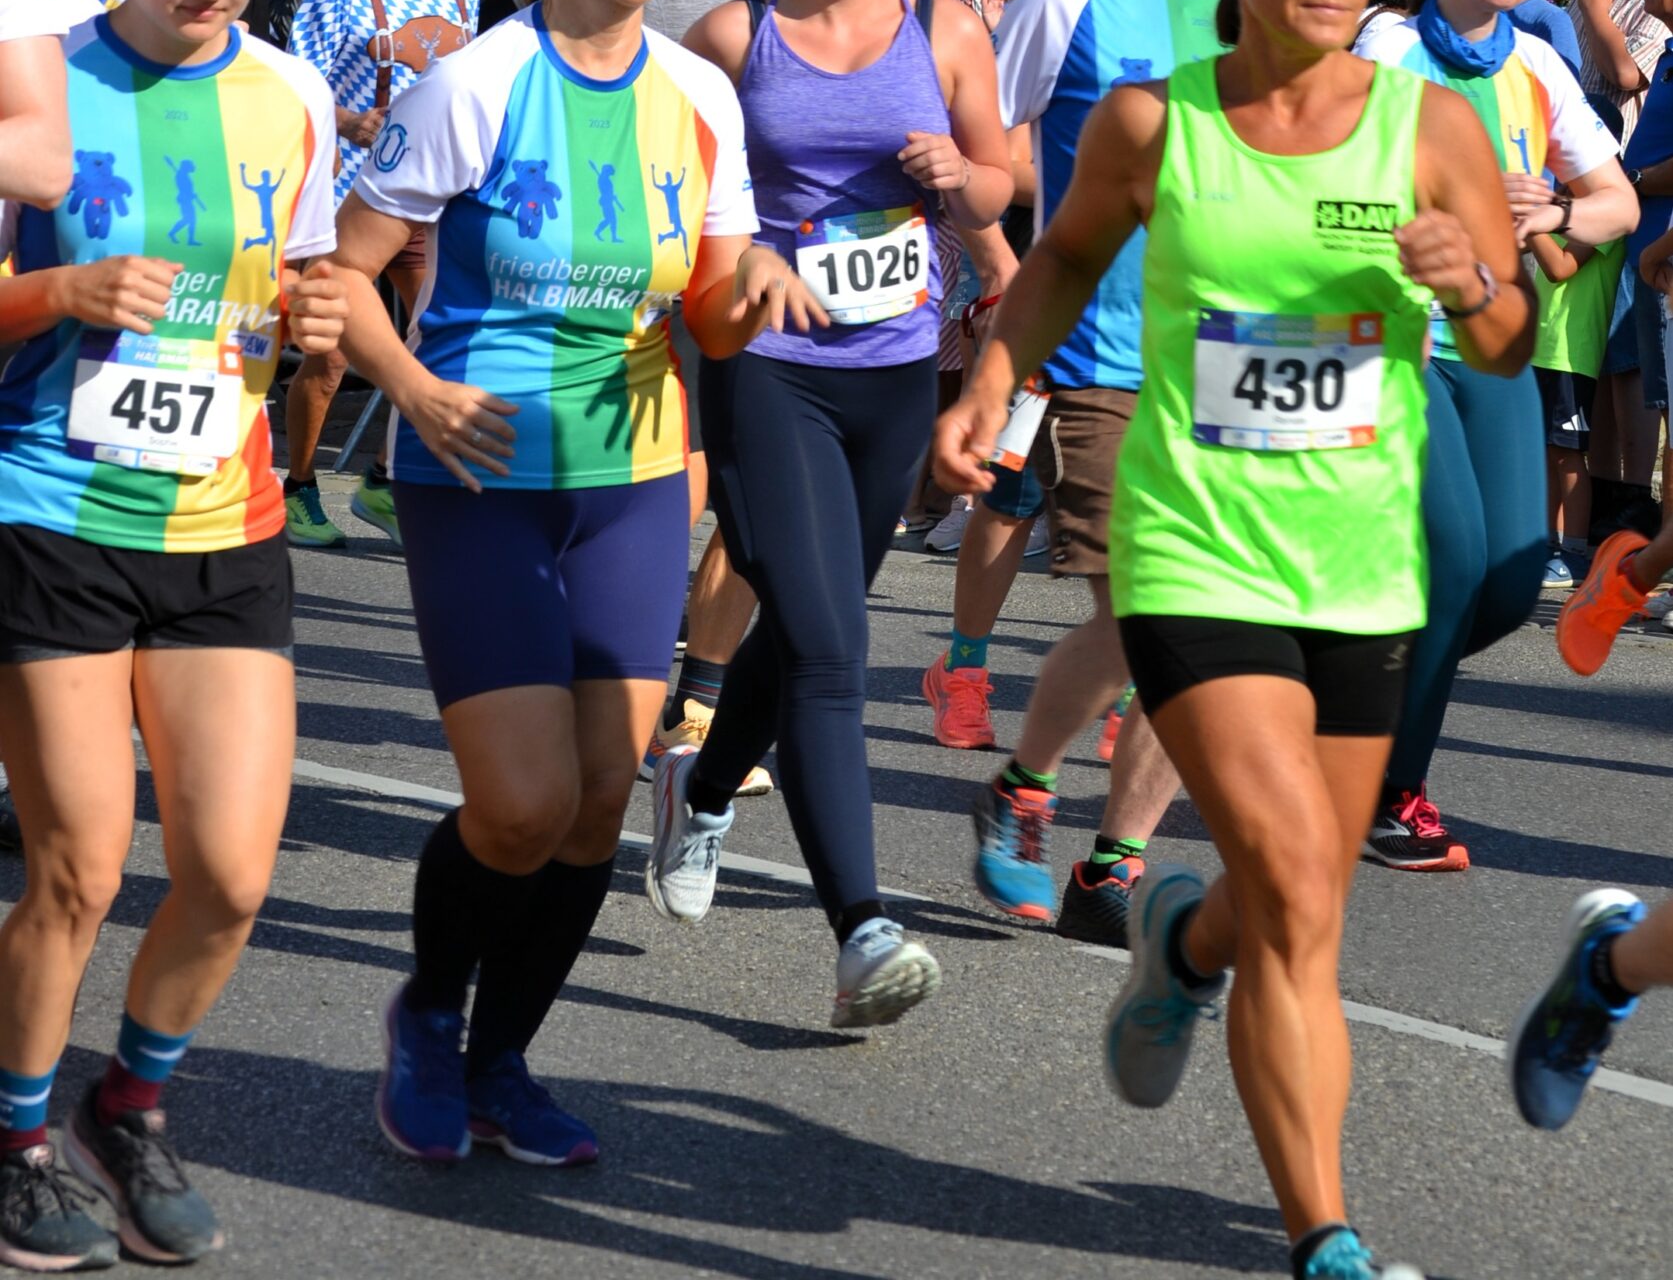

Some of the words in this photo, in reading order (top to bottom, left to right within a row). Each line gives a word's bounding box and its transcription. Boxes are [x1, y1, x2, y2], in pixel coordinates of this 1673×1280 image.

[1342, 203, 1397, 231] DAV
[489, 253, 646, 286] friedberger
[817, 239, 920, 295] 1026
[110, 378, 214, 436] 457
[1233, 358, 1345, 412] 430
